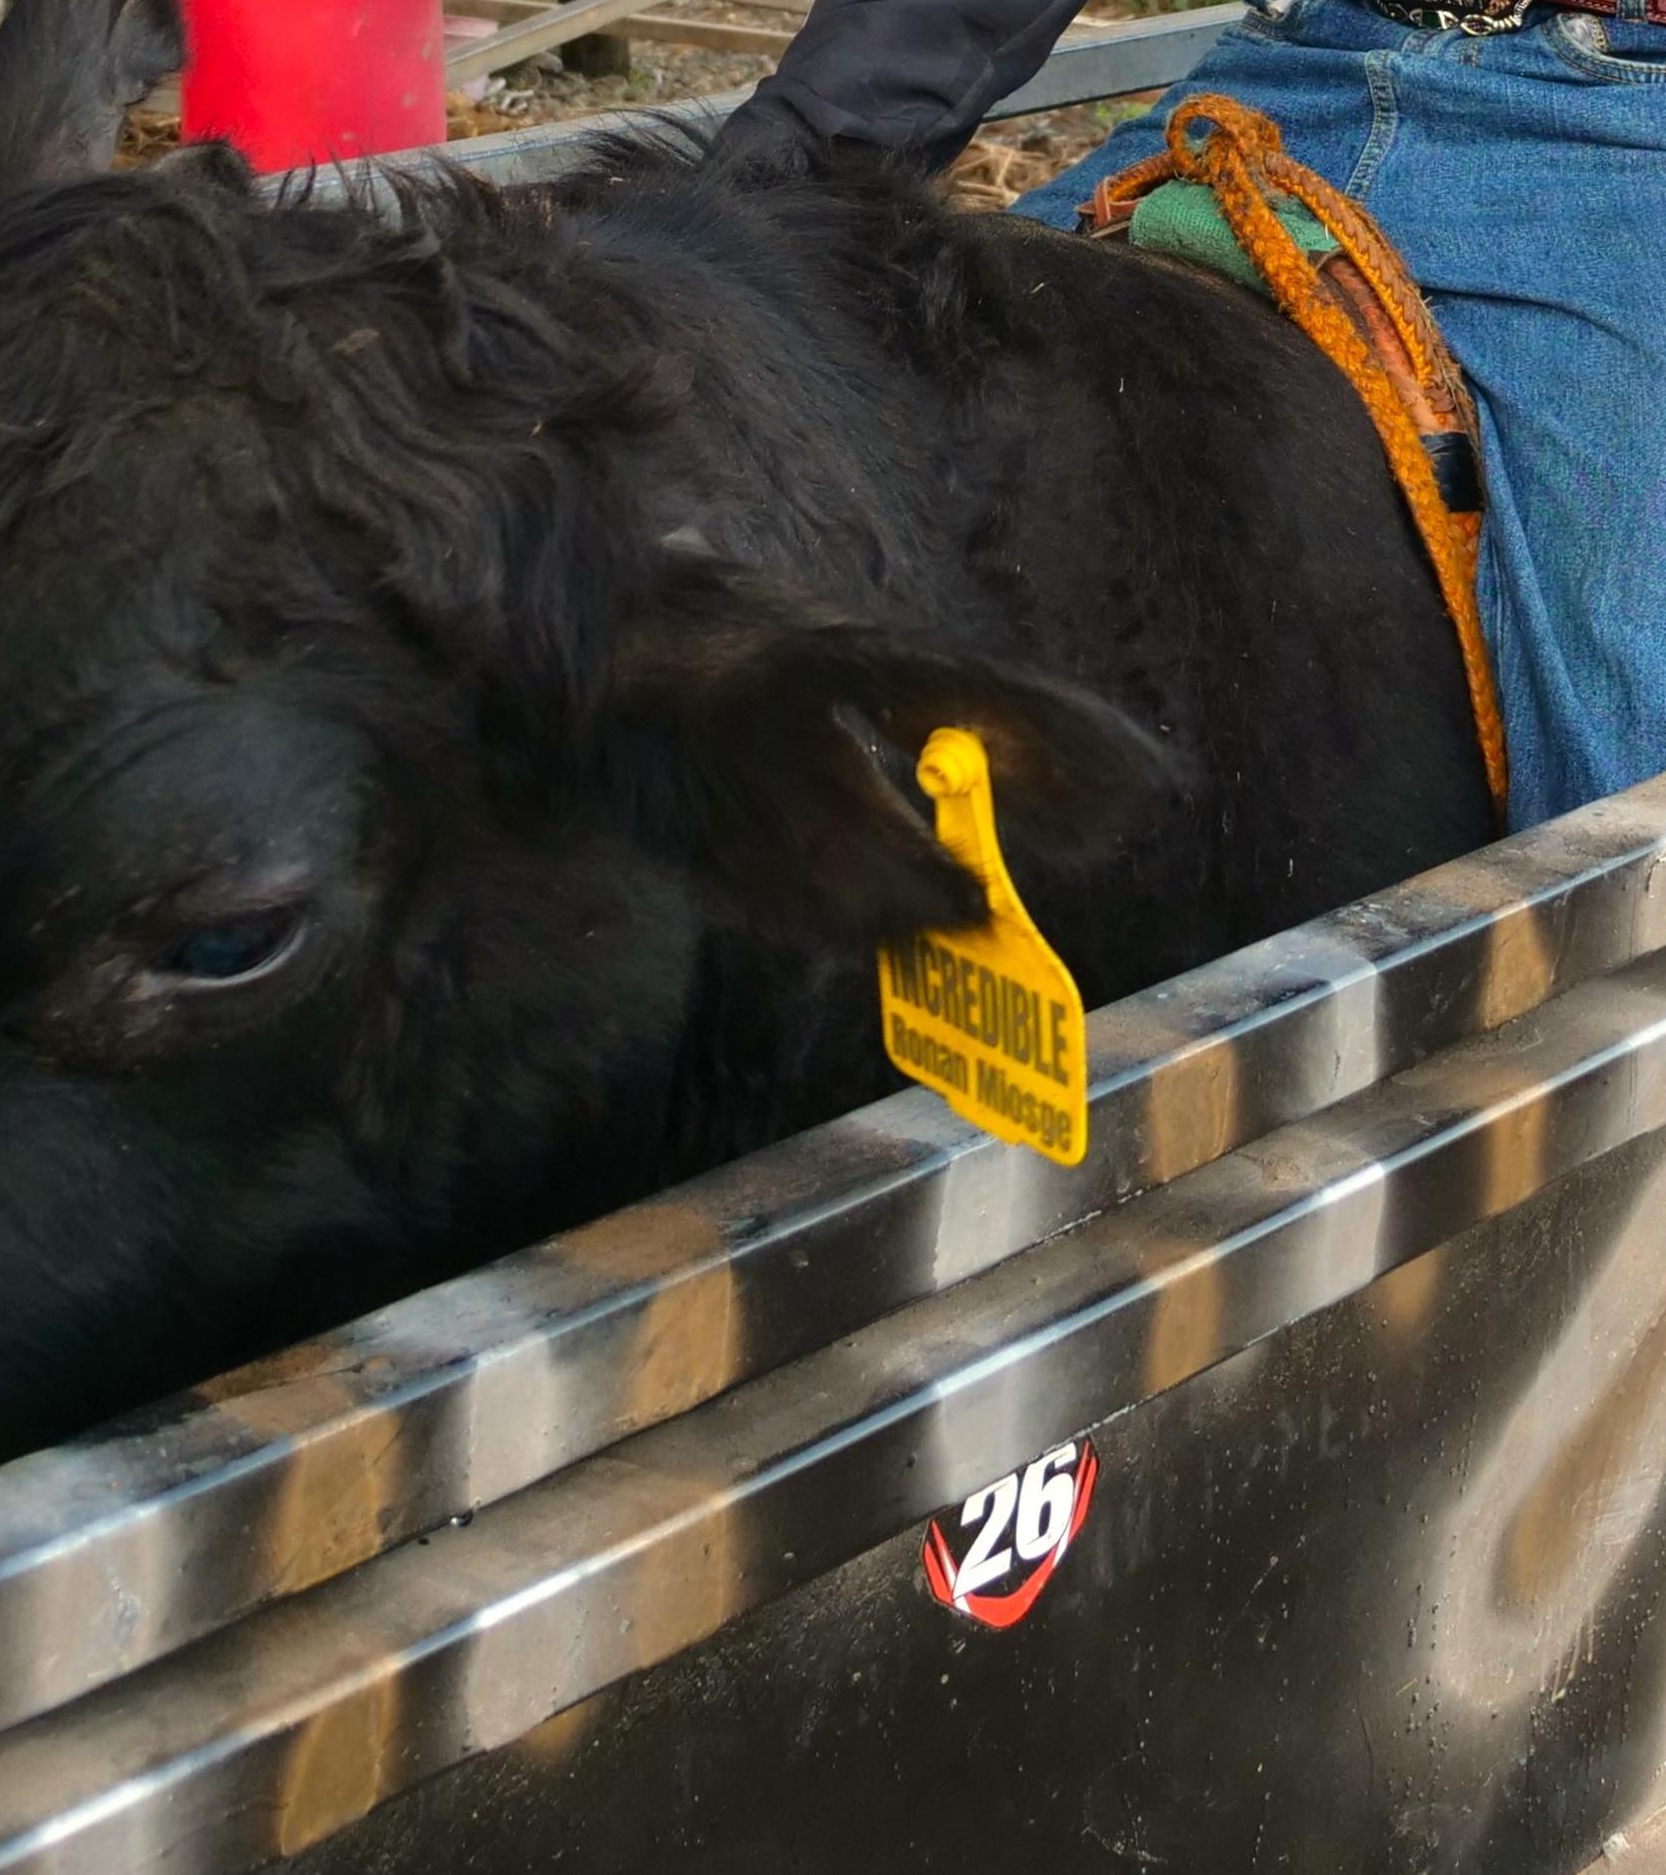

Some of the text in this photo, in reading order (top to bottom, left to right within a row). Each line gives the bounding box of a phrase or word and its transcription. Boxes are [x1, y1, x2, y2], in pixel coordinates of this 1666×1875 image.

[891, 934, 1070, 1088] INCREDIBLE
[891, 1010, 969, 1096] Roman
[952, 1441, 1077, 1601] 26
